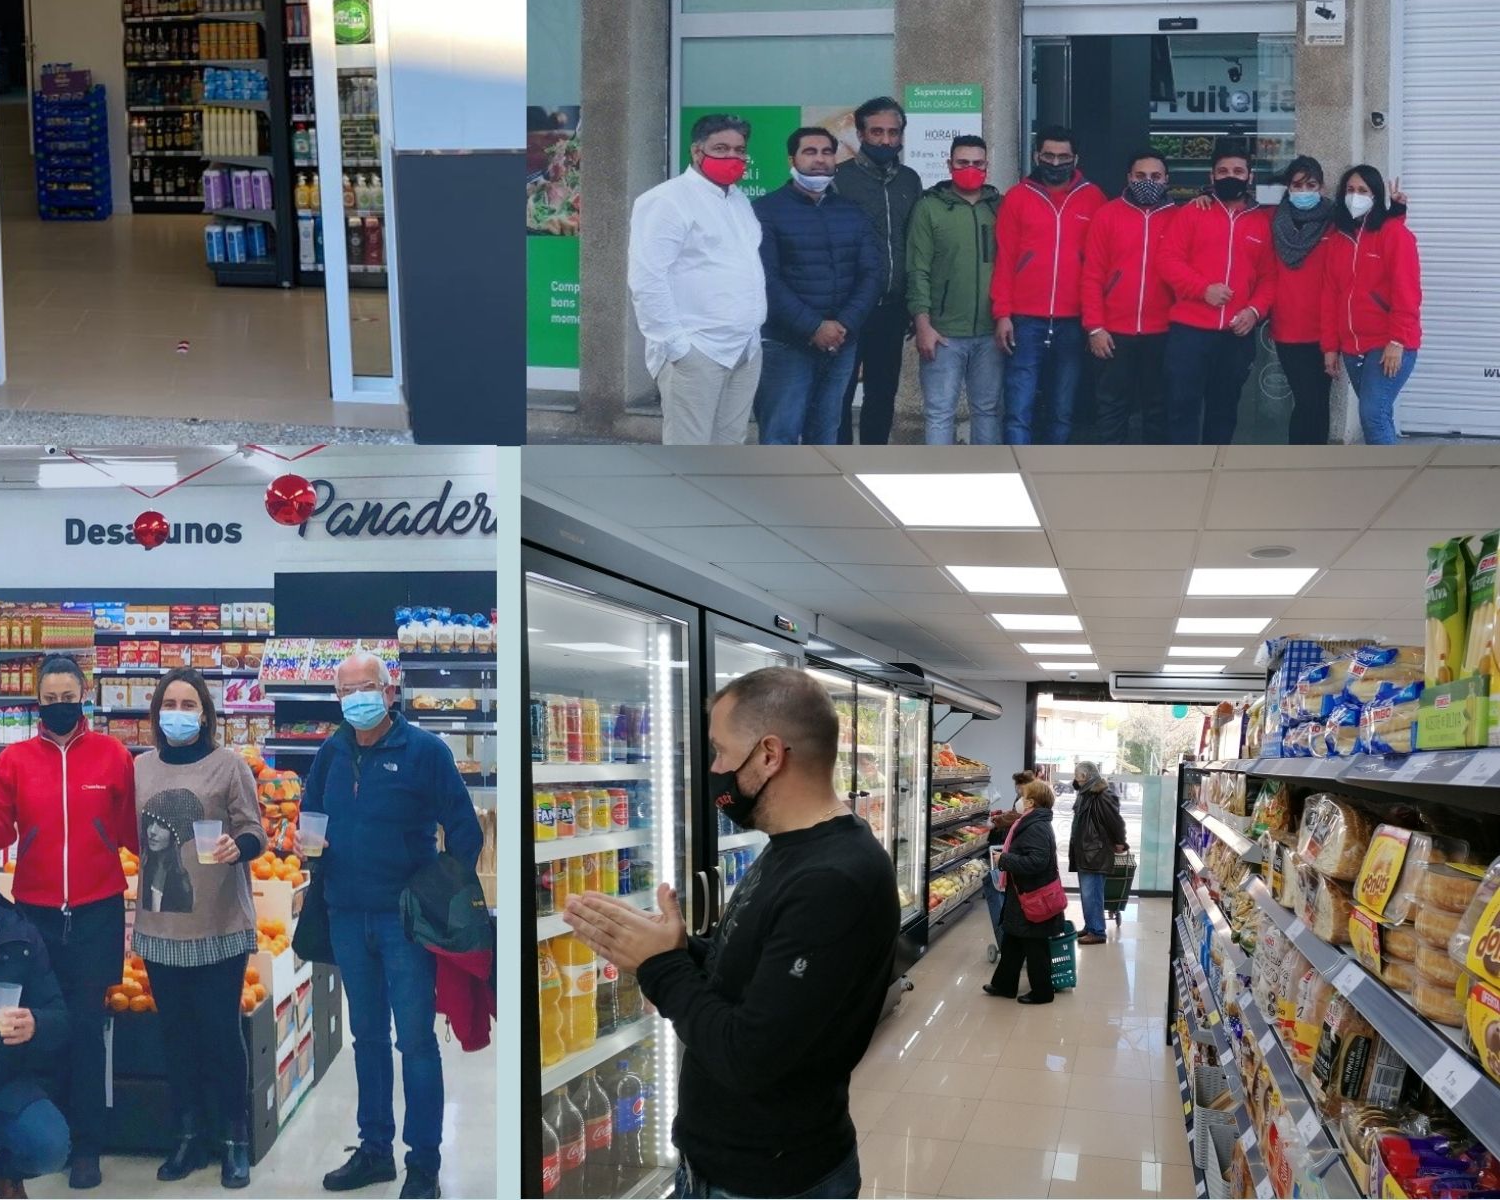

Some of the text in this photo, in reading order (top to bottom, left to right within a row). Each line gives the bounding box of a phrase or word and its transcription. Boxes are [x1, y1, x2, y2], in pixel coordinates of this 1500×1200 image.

[914, 87, 973, 96] Supermercats
[551, 281, 580, 294] Comp
[551, 297, 575, 308] bons
[300, 479, 498, 537] Panader
[66, 518, 242, 551] Desaunos
